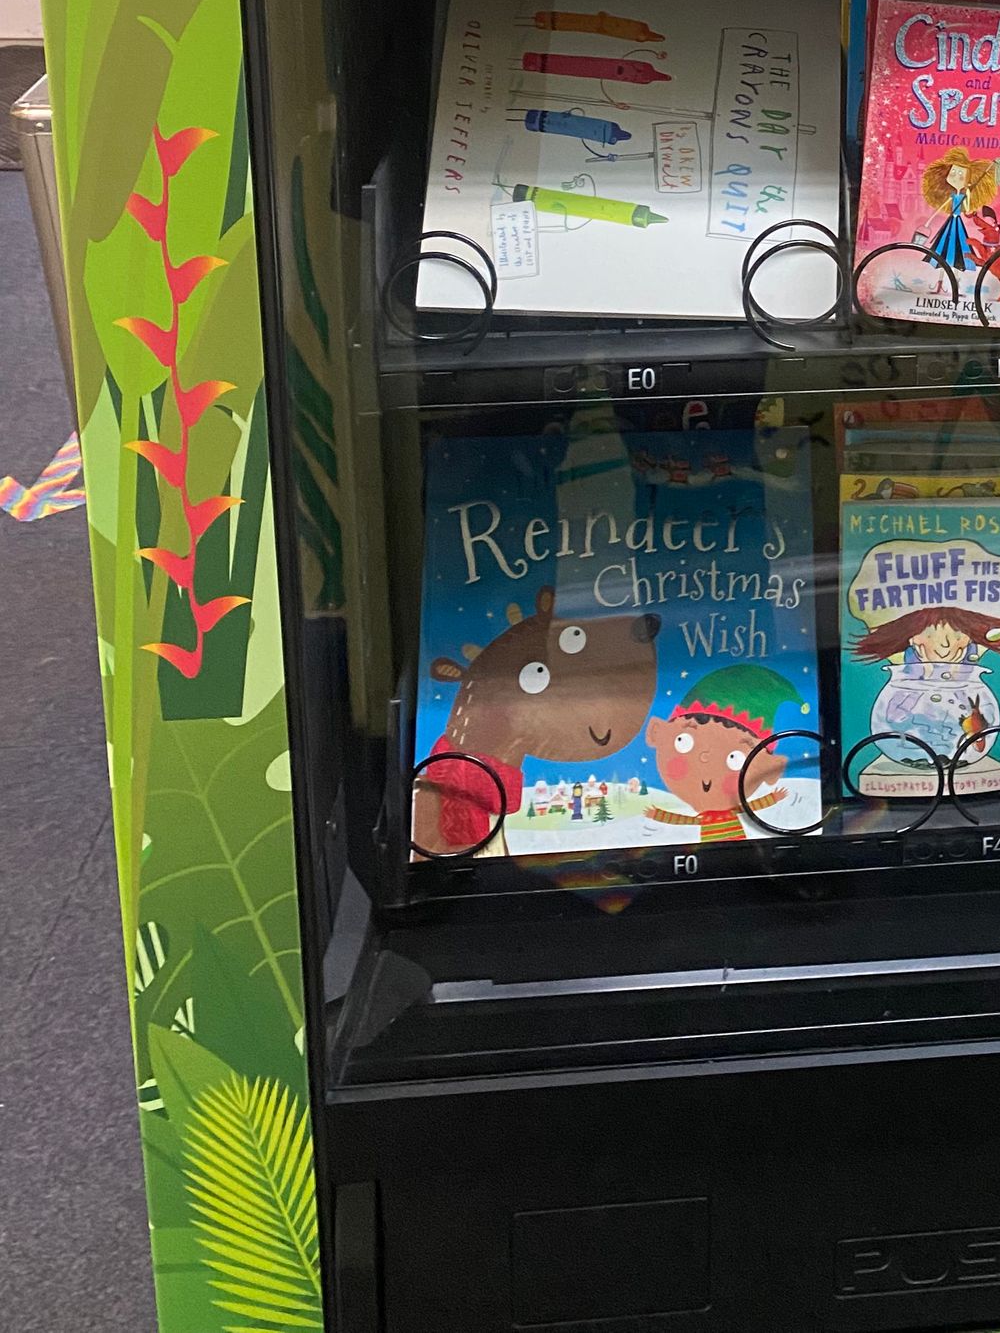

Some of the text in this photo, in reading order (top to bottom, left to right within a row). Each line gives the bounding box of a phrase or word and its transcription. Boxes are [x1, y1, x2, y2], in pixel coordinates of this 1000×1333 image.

[965, 74, 991, 91] and
[444, 20, 481, 194] OLIVER JEFFERS
[714, 32, 768, 233] CRAYONS QUIT
[755, 53, 792, 214] THE DAY the
[915, 132, 960, 146] MAGIC
[909, 309, 940, 317] Illustrated
[916, 297, 960, 311] LINDSEY
[627, 367, 656, 390] E0
[850, 514, 948, 535] MICHAEL
[874, 548, 1000, 584] FLUFF THE
[593, 558, 804, 609] Christmas
[855, 578, 958, 612] FARTING
[680, 610, 769, 659] Wish
[674, 855, 698, 876] F0
